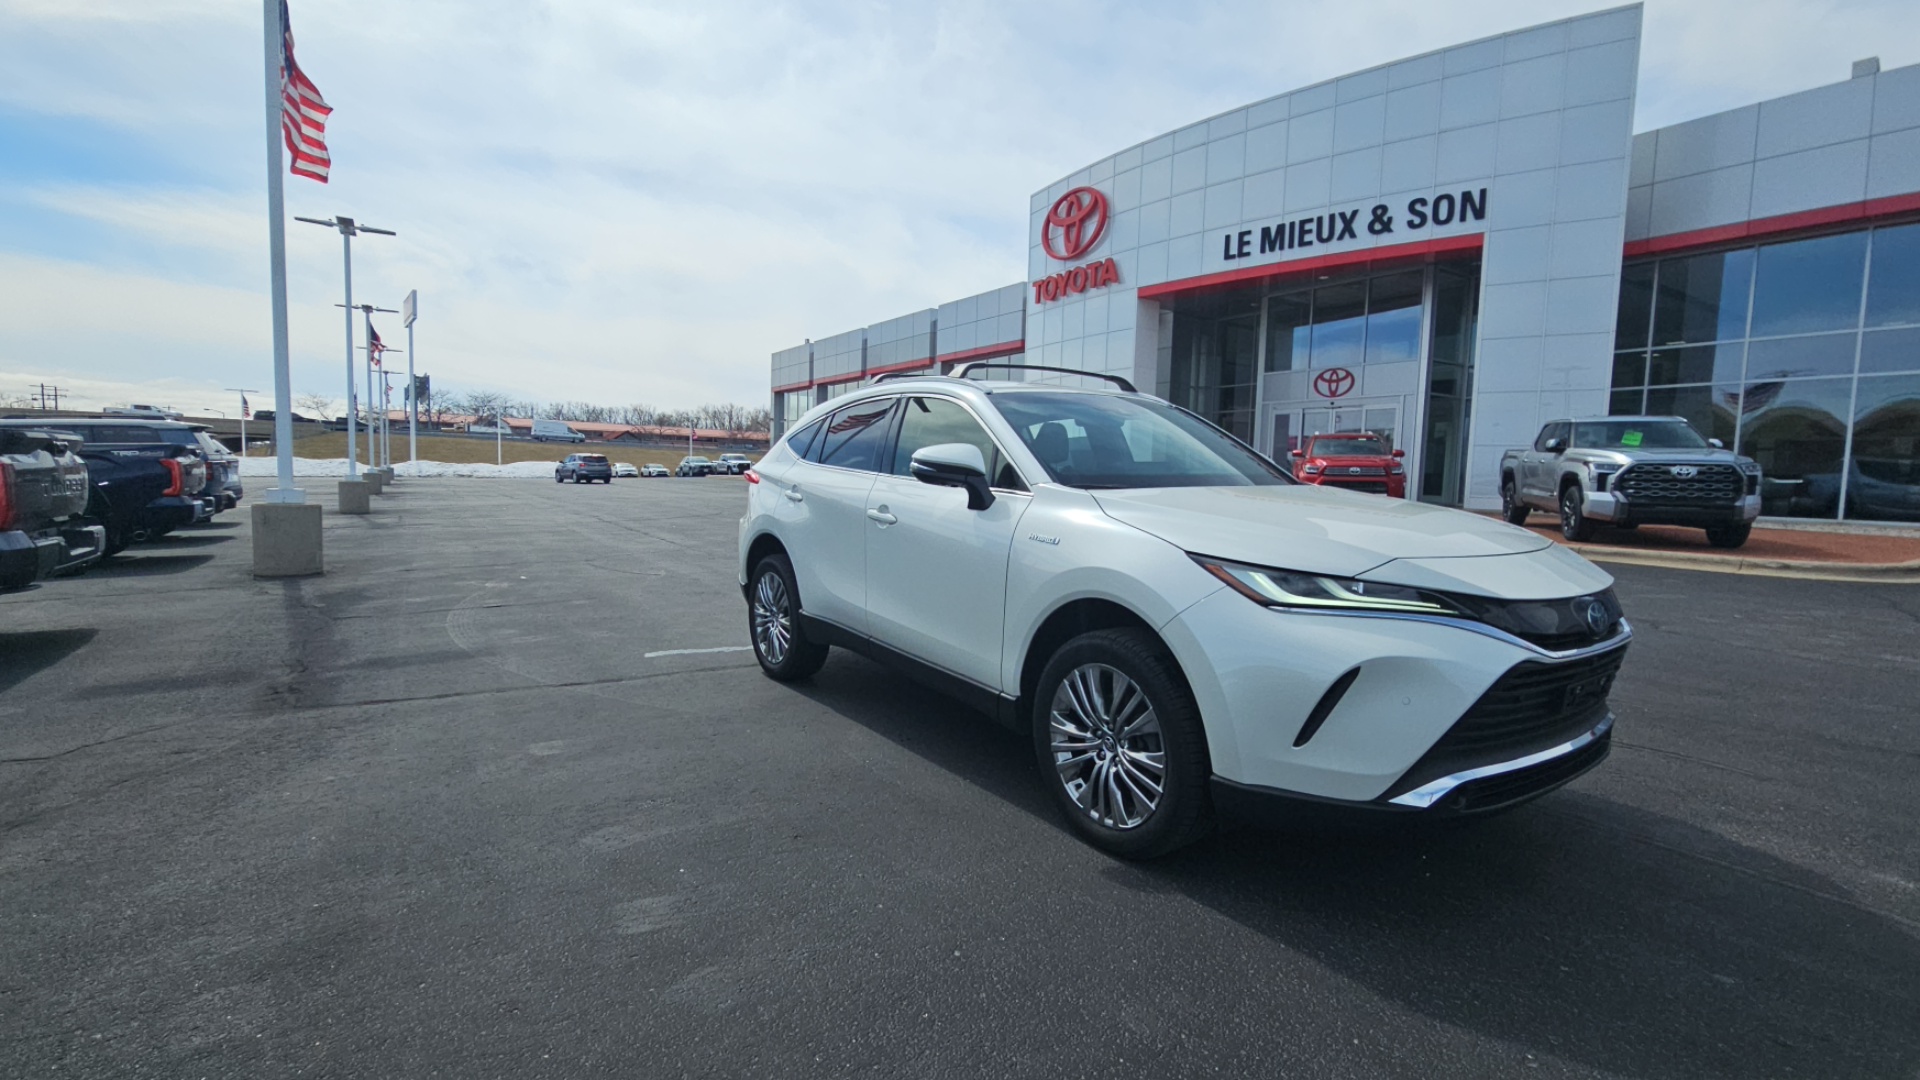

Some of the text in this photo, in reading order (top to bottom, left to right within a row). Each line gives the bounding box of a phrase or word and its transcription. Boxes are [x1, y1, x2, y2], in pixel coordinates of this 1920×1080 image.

[1223, 187, 1488, 261] LE MIEUX & SON
[1032, 257, 1119, 305] TOYOTA
